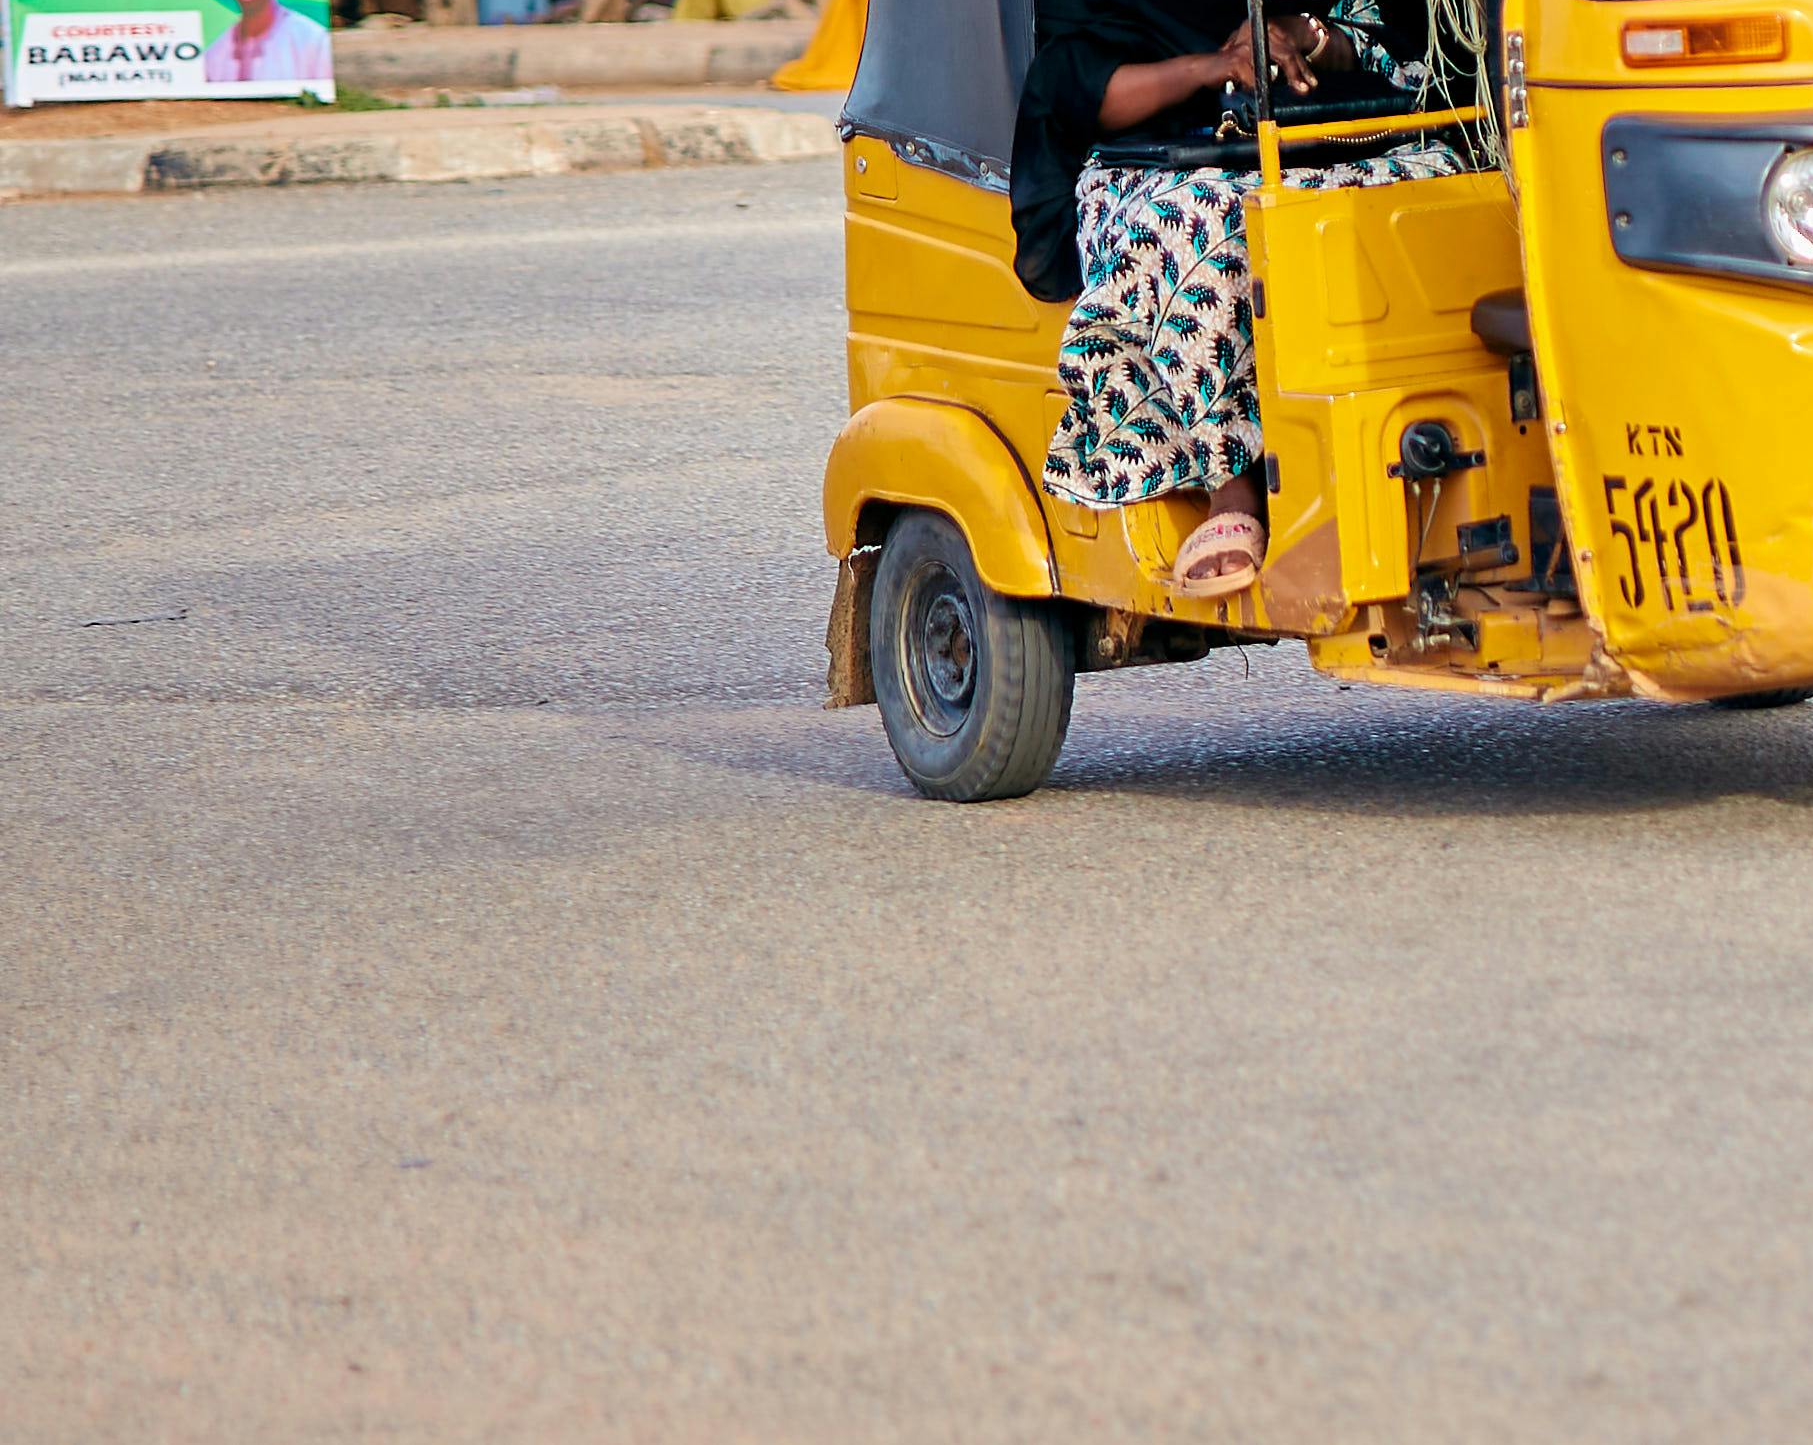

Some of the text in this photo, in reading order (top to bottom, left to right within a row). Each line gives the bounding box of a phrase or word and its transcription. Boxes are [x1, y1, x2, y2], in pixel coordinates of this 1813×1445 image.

[28, 42, 202, 65] BABAWO
[1625, 422, 1684, 457] KTN
[1603, 474, 1746, 612] 5420
